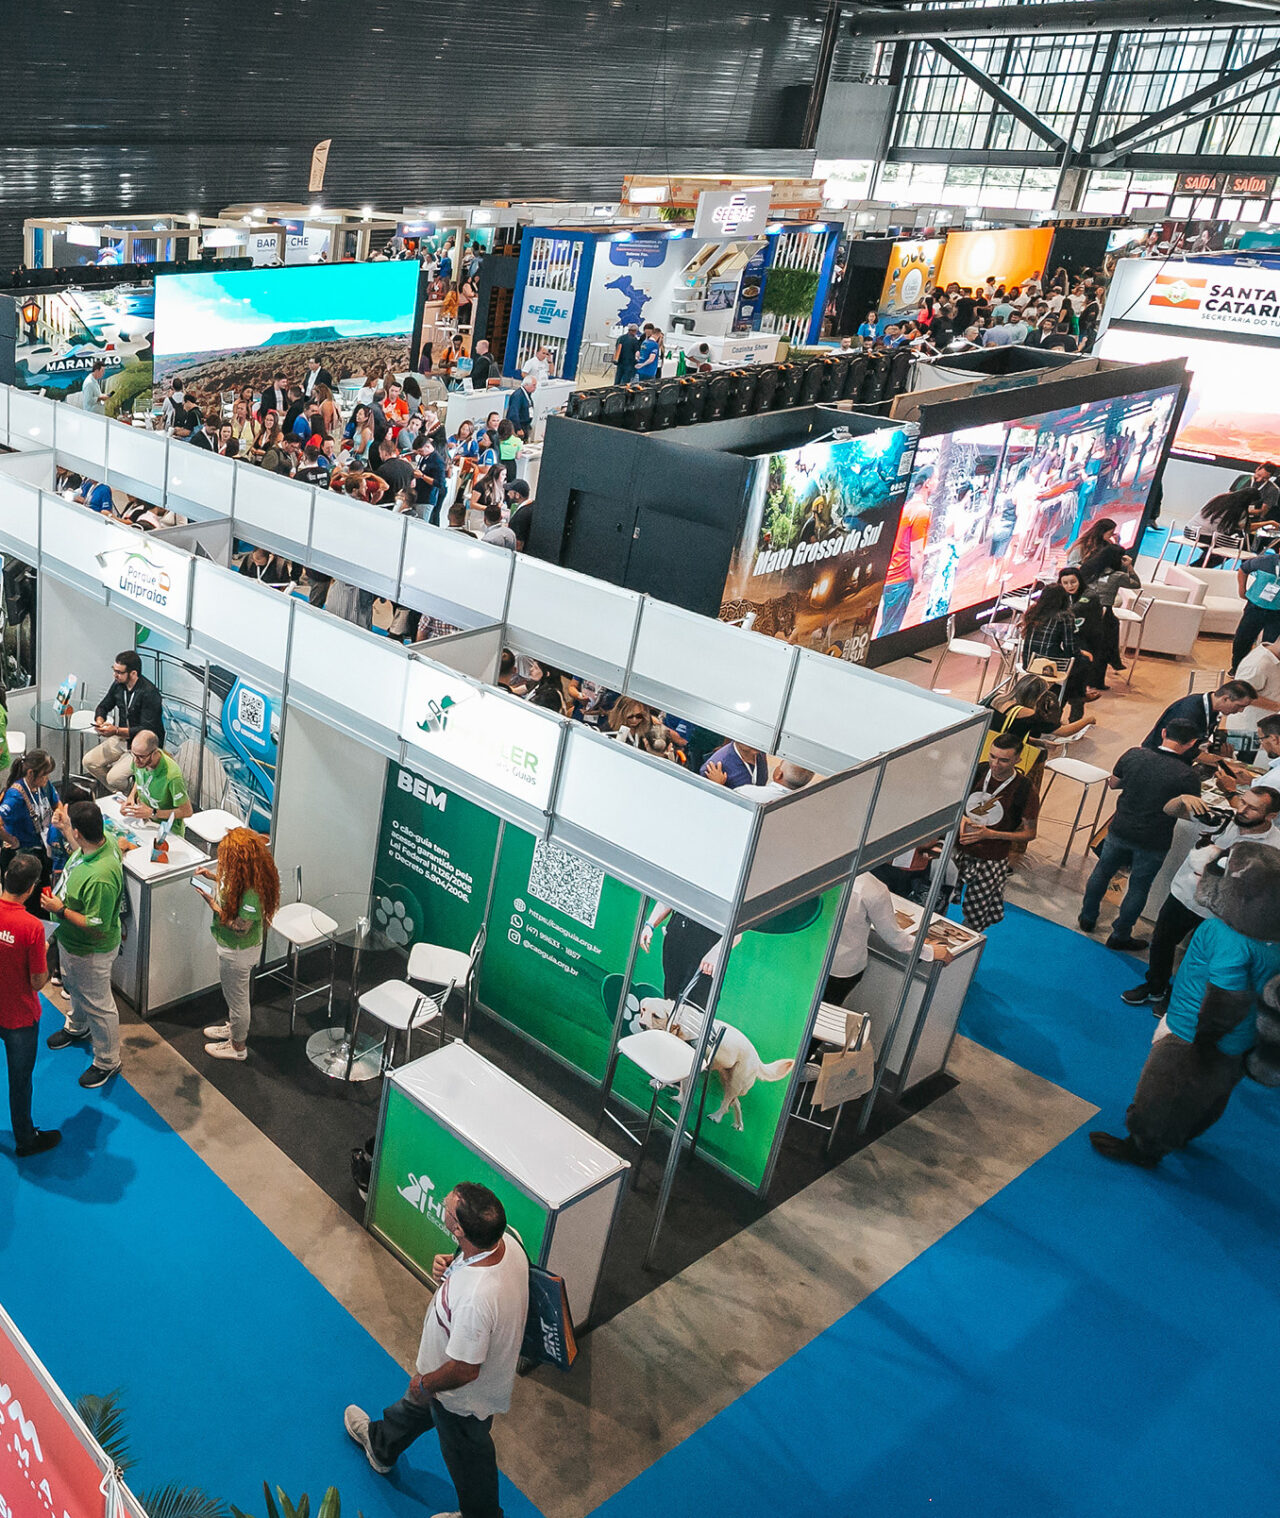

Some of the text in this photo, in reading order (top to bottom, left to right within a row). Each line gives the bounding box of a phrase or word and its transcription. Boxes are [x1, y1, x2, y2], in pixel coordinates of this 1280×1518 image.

[1184, 174, 1216, 190] SAÍDA
[1232, 176, 1266, 192] SAÍDA
[1209, 284, 1278, 303] SANTA
[527, 304, 568, 319] SEBRAE
[1201, 313, 1280, 328] SECRETARIA DO TU
[1205, 299, 1280, 318] CATARI
[753, 521, 885, 577] Mato Grosso do Sul
[128, 565, 157, 586] Parque
[119, 575, 168, 607] Unipraias
[397, 769, 448, 812] BEM
[392, 820, 450, 859] O cão-guia tem
[388, 849, 394, 857] e
[394, 852, 424, 875] Decreto
[389, 838, 401, 851] Lei
[401, 845, 430, 869] Federal
[391, 830, 473, 884] acesso garantido pela
[523, 939, 579, 977] @caoguia.org.br
[426, 1210, 450, 1237] Escola
